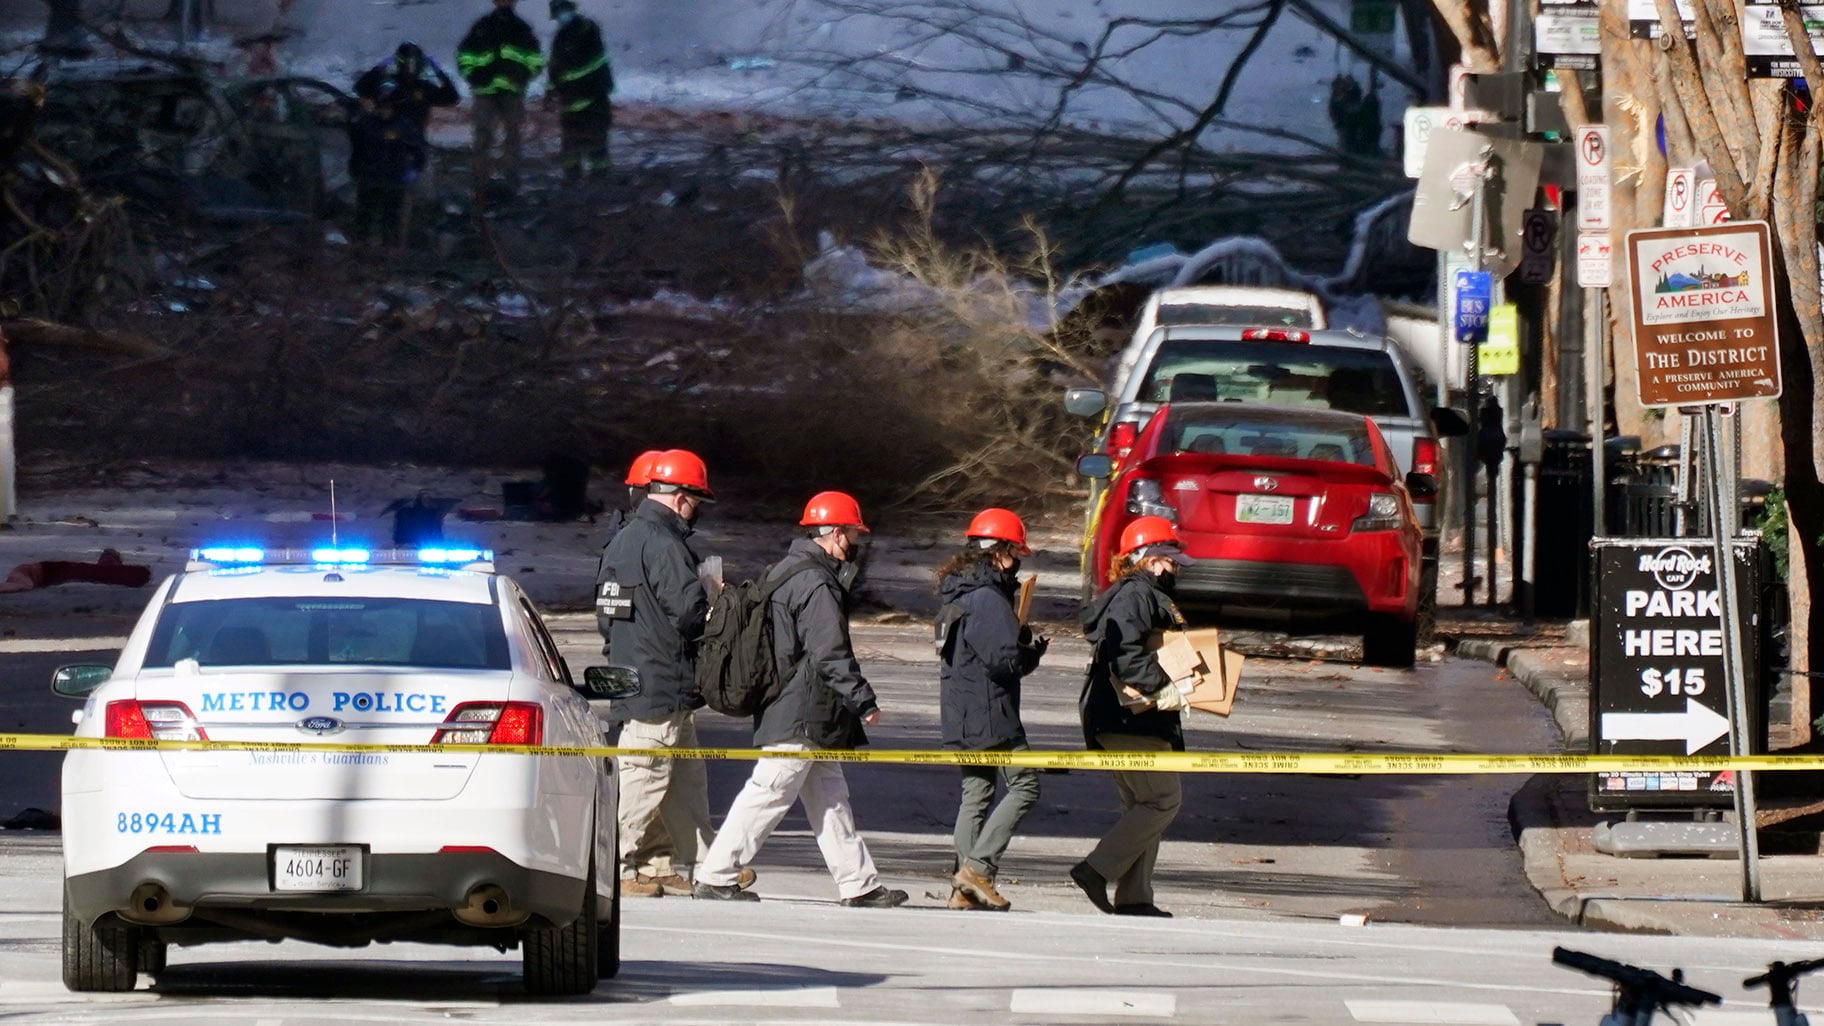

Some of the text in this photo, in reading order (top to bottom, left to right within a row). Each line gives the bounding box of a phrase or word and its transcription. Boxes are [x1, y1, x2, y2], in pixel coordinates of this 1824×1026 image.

[1651, 243, 1747, 273] PRESERVE
[1656, 290, 1749, 309] AMERICA
[1646, 305, 1760, 323] Explore and Enjoy Our Heritage
[1657, 328, 1754, 344] WELCOME TO
[1652, 368, 1764, 384] A PRESERVE AMERICA
[1677, 380, 1741, 393] COMMUNITY
[1639, 554, 1711, 574] Hard Rock
[602, 581, 620, 596] FBI
[1626, 591, 1721, 617] PARK
[1626, 630, 1722, 656] HERE
[1641, 668, 1706, 698] $15
[201, 692, 446, 714] METRO POLICE
[308, 718, 331, 729] Ford
[249, 751, 389, 765] Nashville's Guardians
[117, 812, 222, 834] 8894AH
[294, 848, 341, 858] TENNESSEE
[286, 859, 351, 878] 4604-GF
